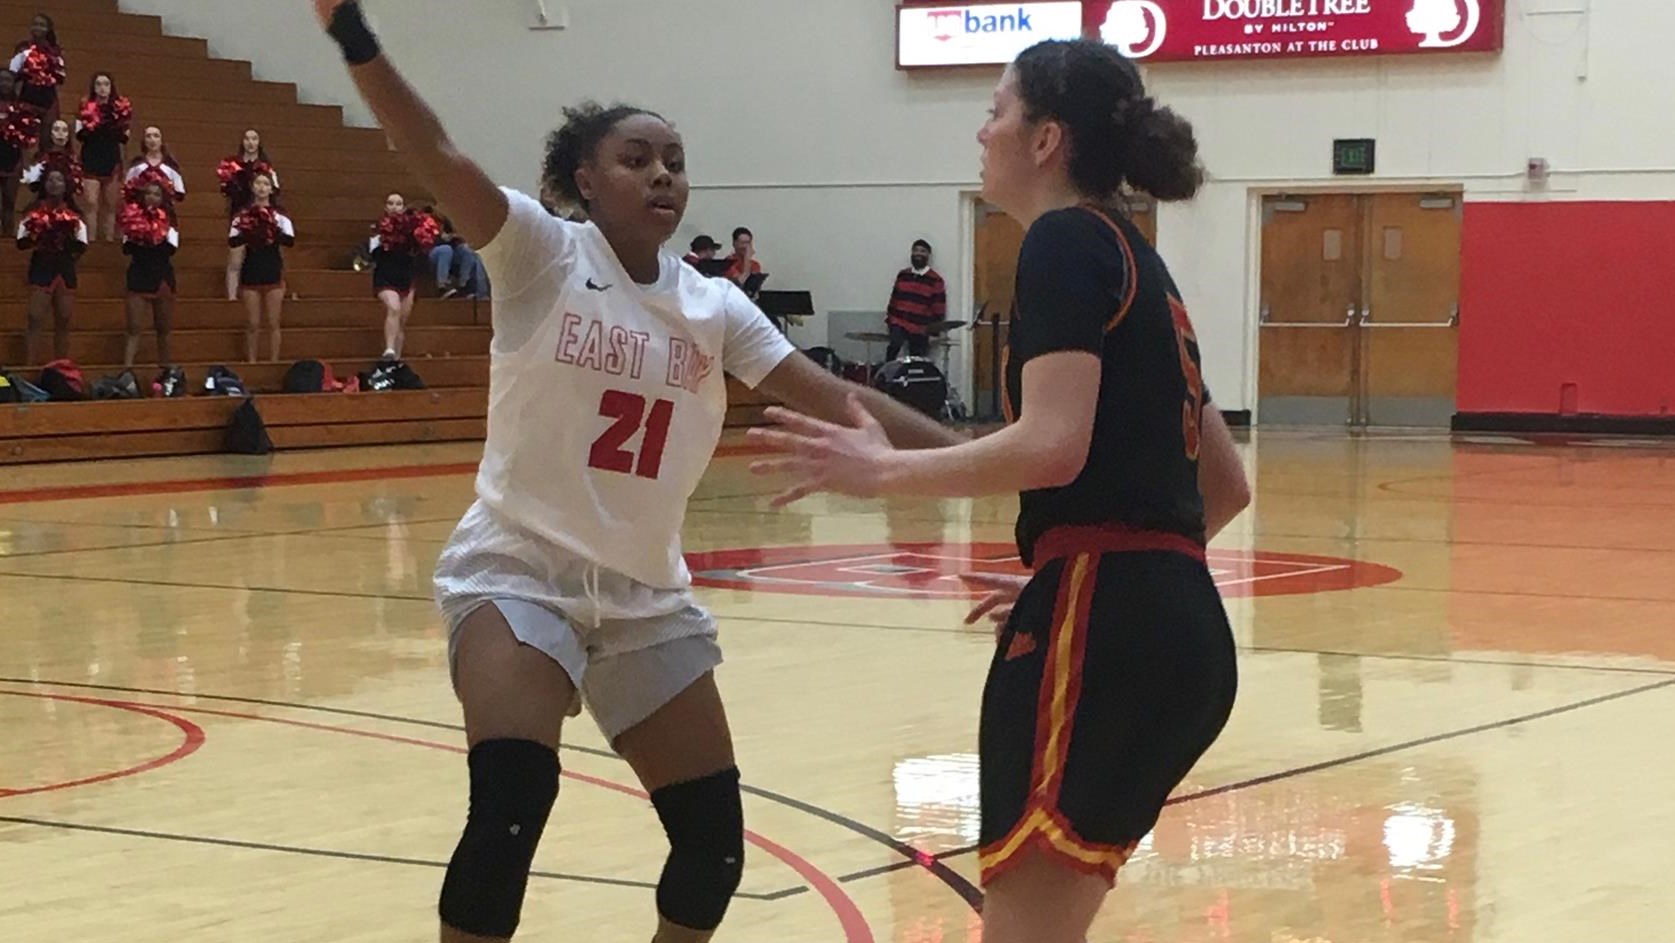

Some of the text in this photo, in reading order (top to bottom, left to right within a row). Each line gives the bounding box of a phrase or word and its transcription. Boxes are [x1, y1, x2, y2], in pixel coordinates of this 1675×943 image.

[964, 8, 1032, 33] bank
[1244, 24, 1263, 34] BY
[1194, 38, 1379, 56] PLEASANTON AT THE CLUB
[555, 312, 649, 380] EAST
[587, 389, 675, 480] 21
